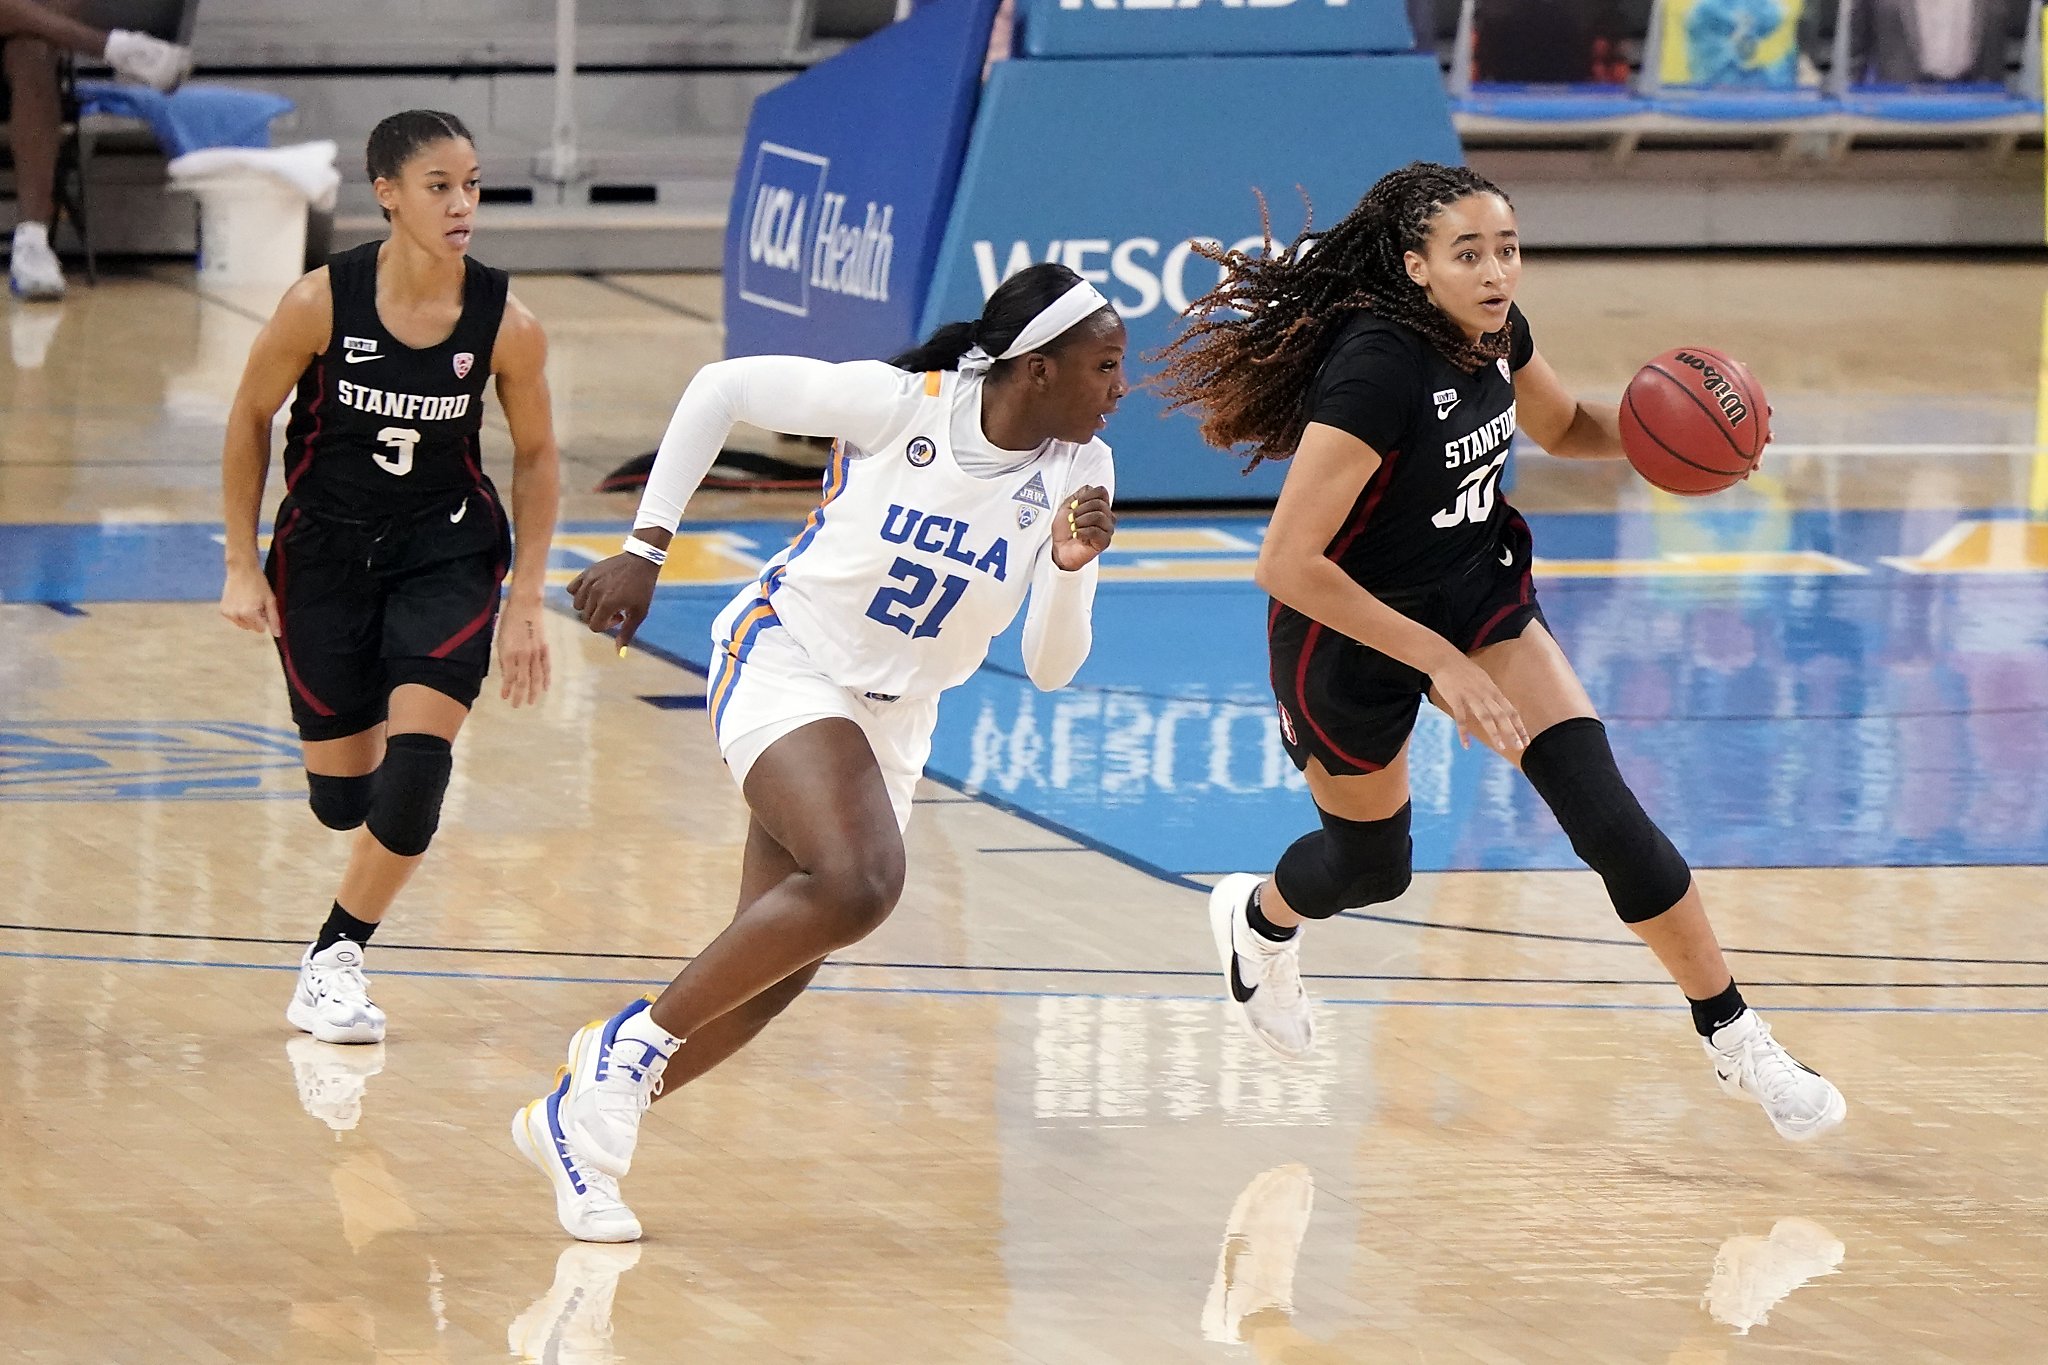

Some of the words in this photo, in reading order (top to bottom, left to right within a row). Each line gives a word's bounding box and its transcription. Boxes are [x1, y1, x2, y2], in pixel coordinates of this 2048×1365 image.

[750, 184, 807, 273] UCLA
[810, 191, 894, 303] Health
[973, 236, 1325, 319] WESCO
[338, 379, 471, 421] STANFORD
[1674, 351, 1748, 430] Wilson
[371, 426, 422, 476] 3
[1444, 399, 1517, 469] STANFOR
[1020, 488, 1046, 503] JRW
[1431, 448, 1509, 529] 30
[879, 503, 1009, 583] UCLA
[865, 556, 970, 640] 21
